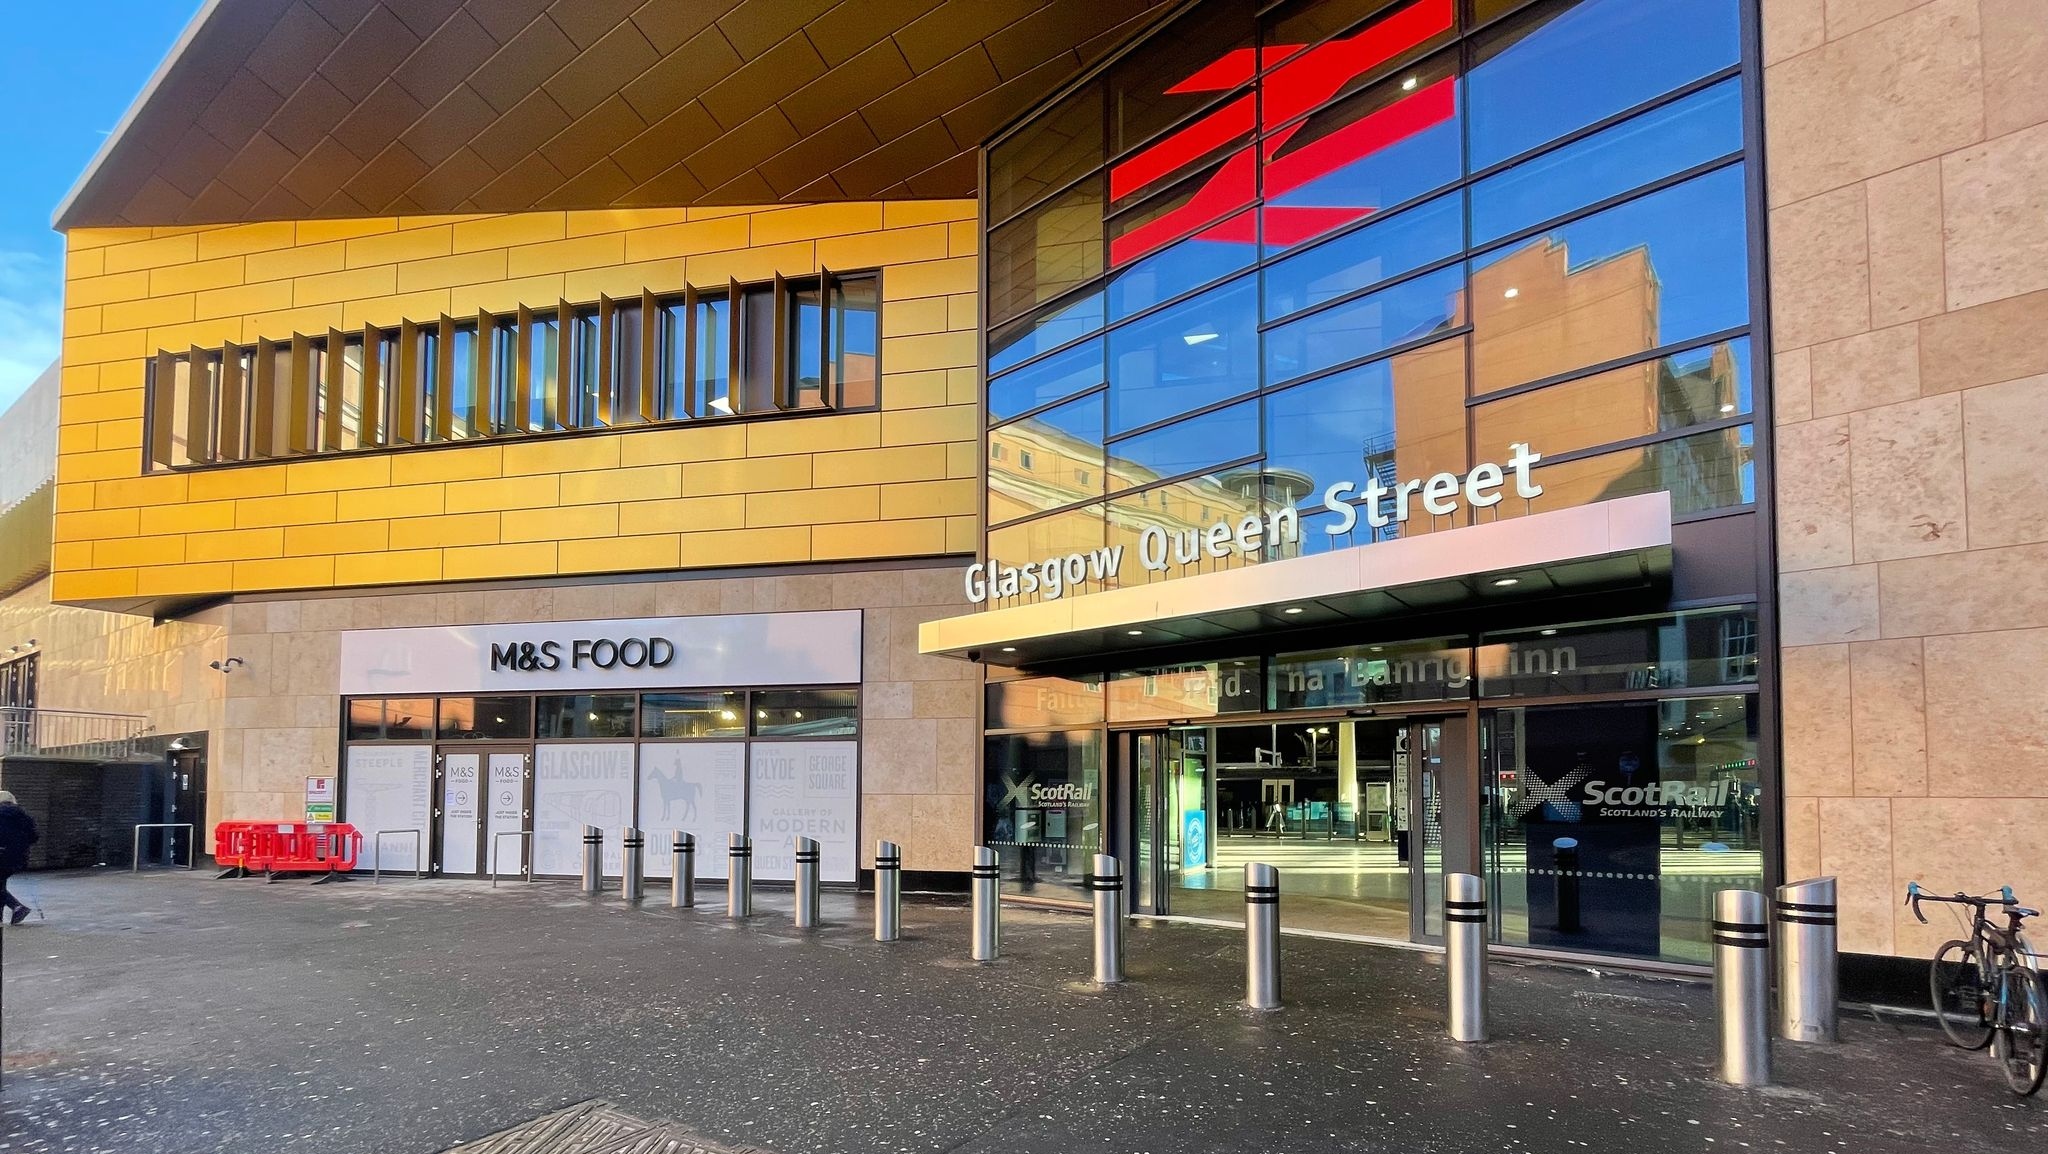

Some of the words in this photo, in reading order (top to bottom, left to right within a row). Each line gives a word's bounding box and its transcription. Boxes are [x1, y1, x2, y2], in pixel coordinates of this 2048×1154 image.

[964, 542, 1123, 604] Glasgow
[1139, 505, 1299, 572] Queen
[1324, 443, 1544, 537] Street
[490, 639, 560, 672] M&S
[571, 637, 675, 670] FOOD
[355, 758, 404, 768] STEEPLE
[541, 751, 618, 779] GLASGOW
[756, 758, 795, 780] CLYDE
[809, 755, 847, 772] GEORGE
[451, 767, 475, 778] M&S
[495, 767, 520, 778] M&S
[809, 773, 847, 790] SQUARE
[1030, 782, 1093, 800] ScotRail
[1582, 779, 1730, 806] ScotRail
[772, 808, 816, 817] GALLERY
[819, 808, 833, 817] OF
[1599, 807, 1667, 818] SCOTLAND'S
[1669, 807, 1725, 819] RAILWAY
[760, 818, 846, 833] MODERN
[754, 855, 781, 870] QUEEN
